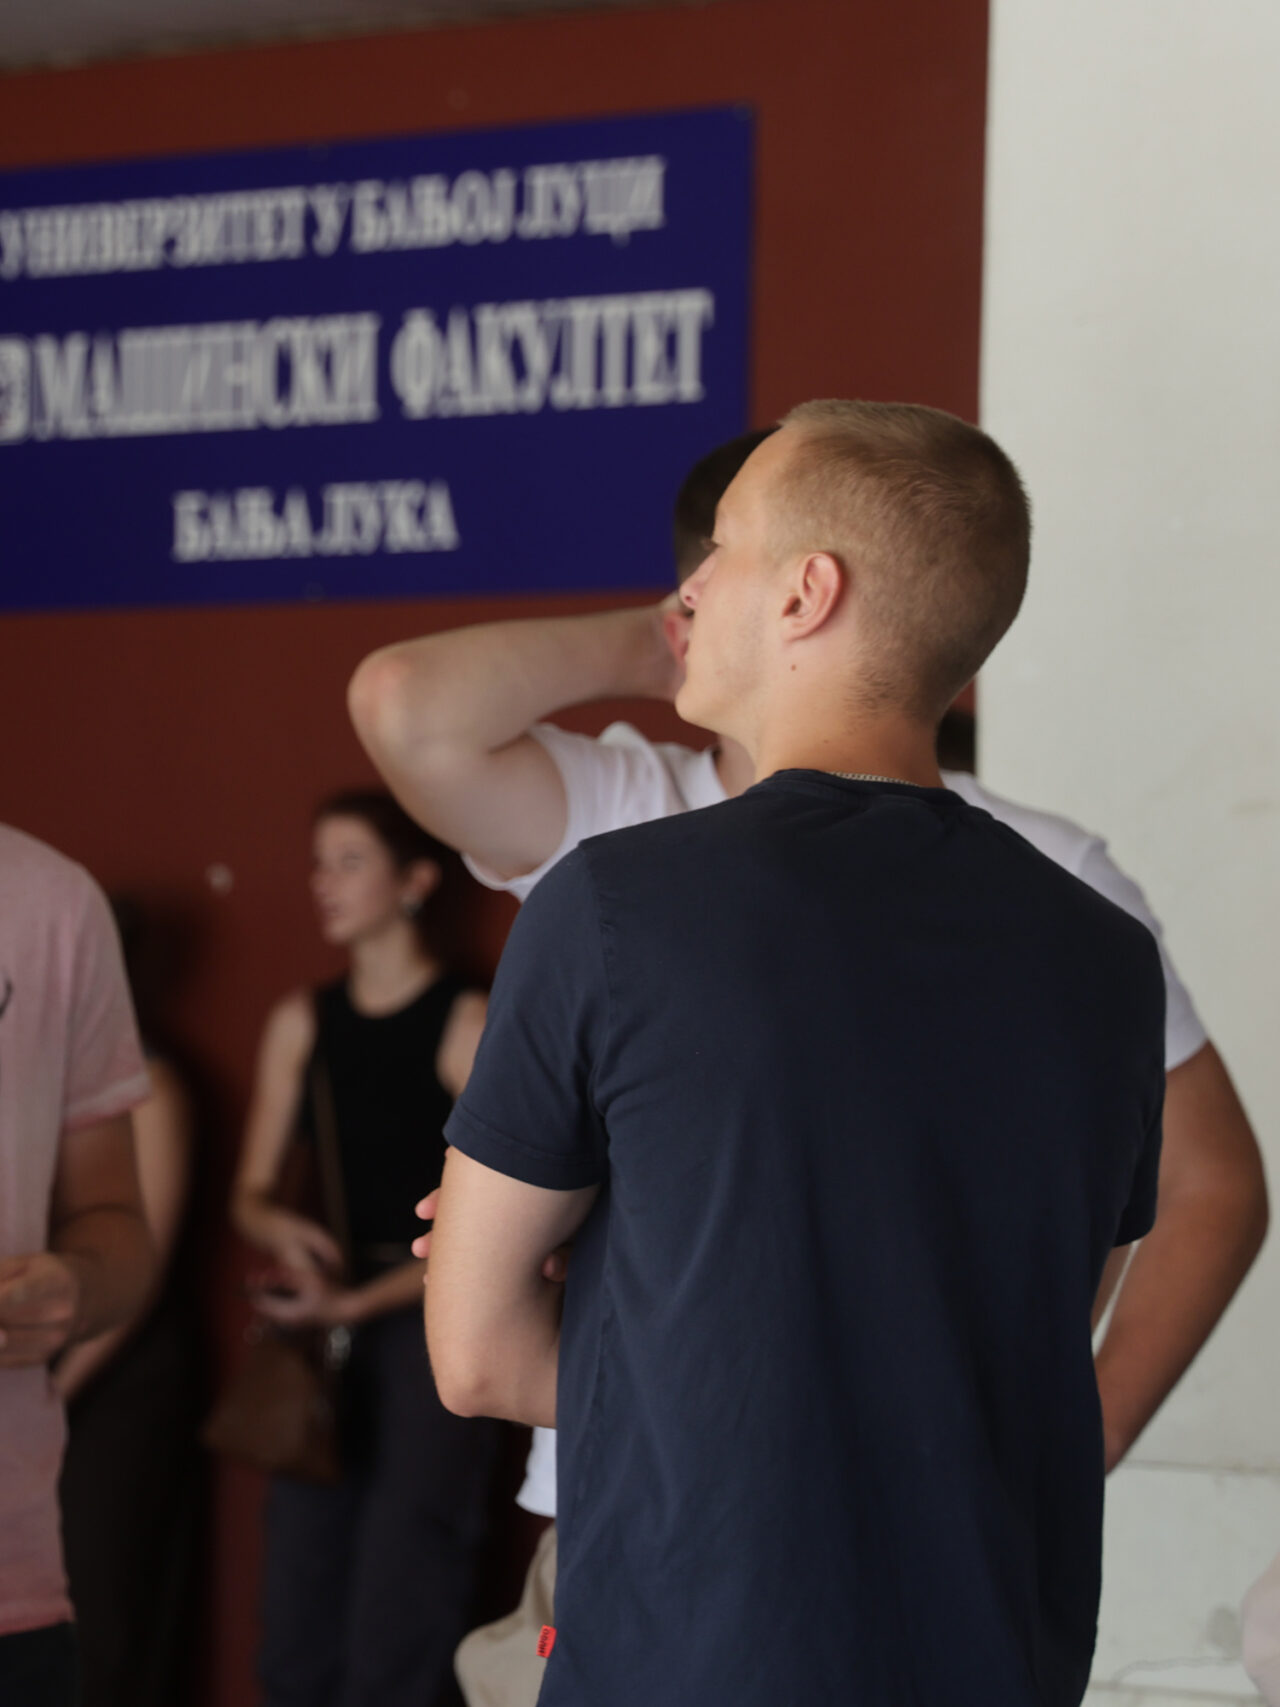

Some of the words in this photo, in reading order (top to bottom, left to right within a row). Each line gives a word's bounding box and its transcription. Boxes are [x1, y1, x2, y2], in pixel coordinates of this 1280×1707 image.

[312, 182, 350, 256] У
[350, 168, 518, 253] БАЊОЈ
[518, 155, 667, 245] ЛУЦИ
[33, 312, 381, 442] МАШИНСКИ
[390, 287, 716, 420] ФАКУЛТЕТ
[172, 486, 315, 562] БАЊА
[313, 480, 460, 554] ЛУКА
